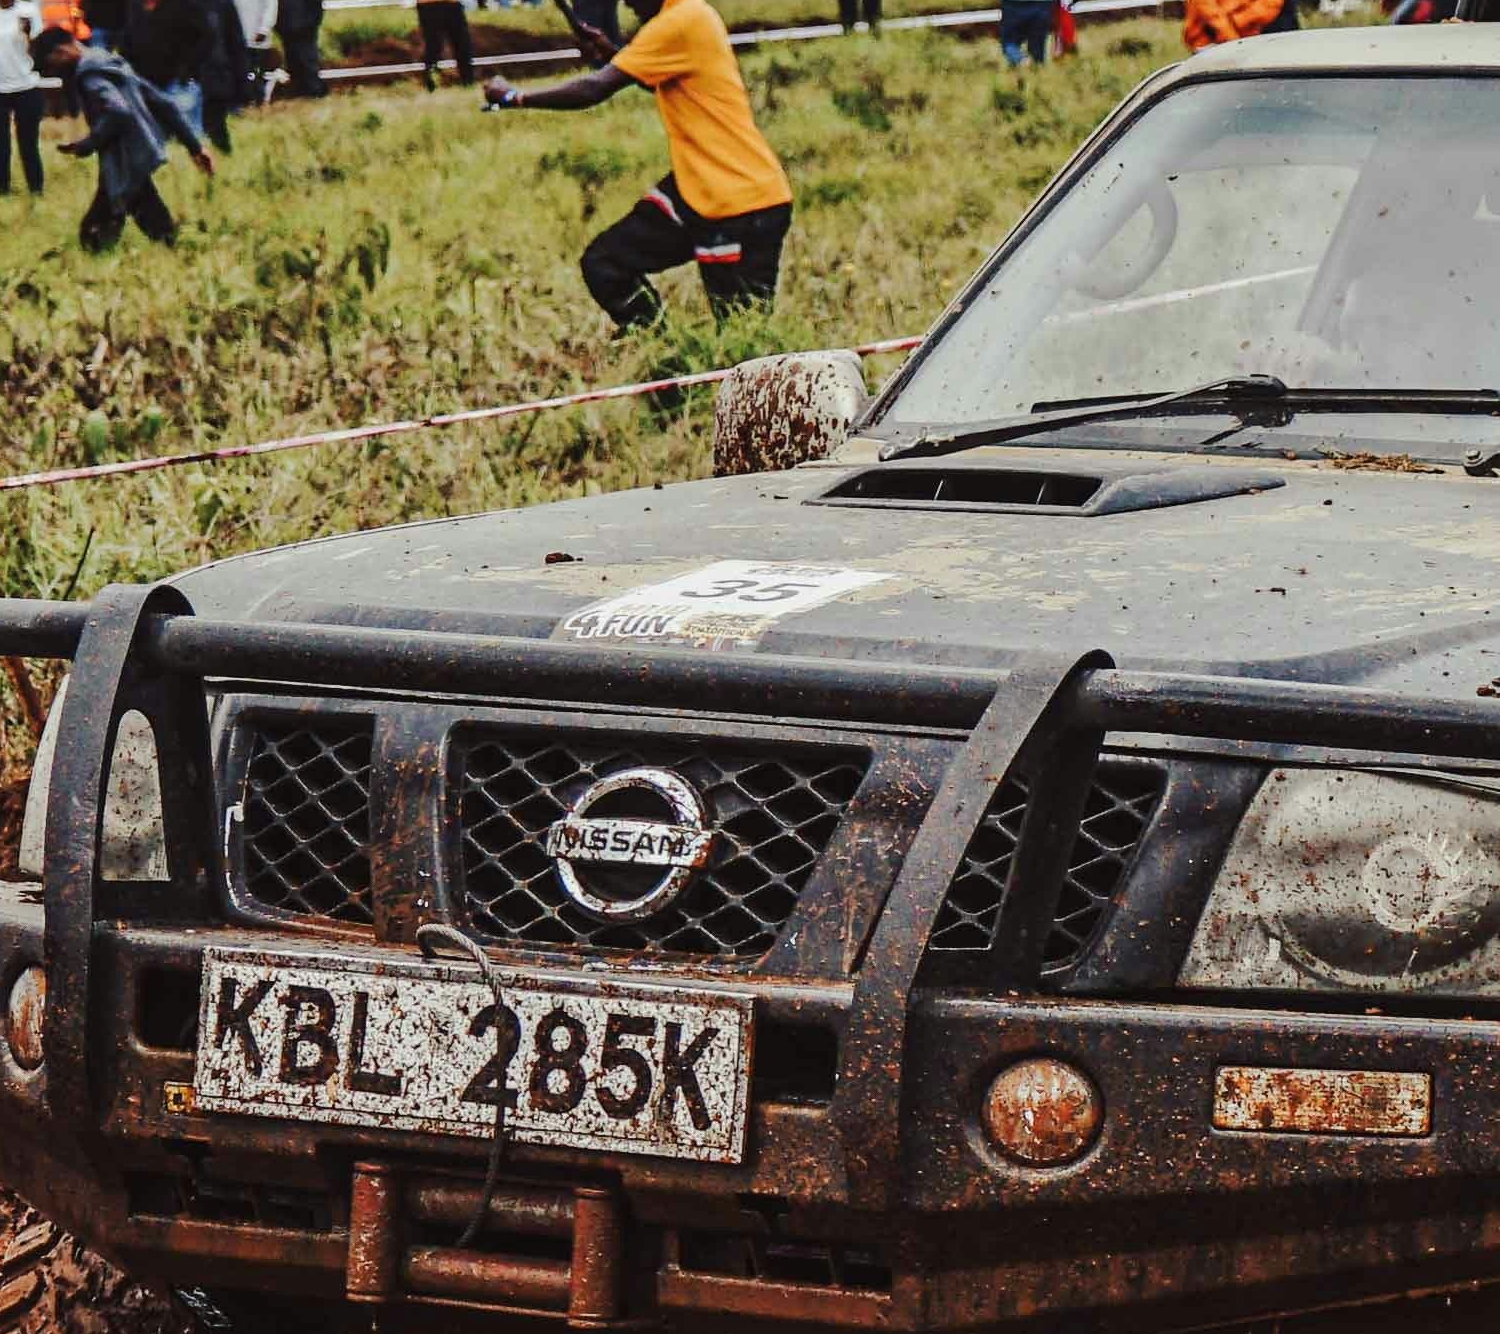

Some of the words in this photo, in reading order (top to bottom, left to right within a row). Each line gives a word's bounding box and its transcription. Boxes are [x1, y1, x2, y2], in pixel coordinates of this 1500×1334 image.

[680, 578, 820, 602] 35
[555, 824, 692, 858] NISSAN
[213, 975, 401, 1096] KBL
[462, 1003, 719, 1133] 285K
